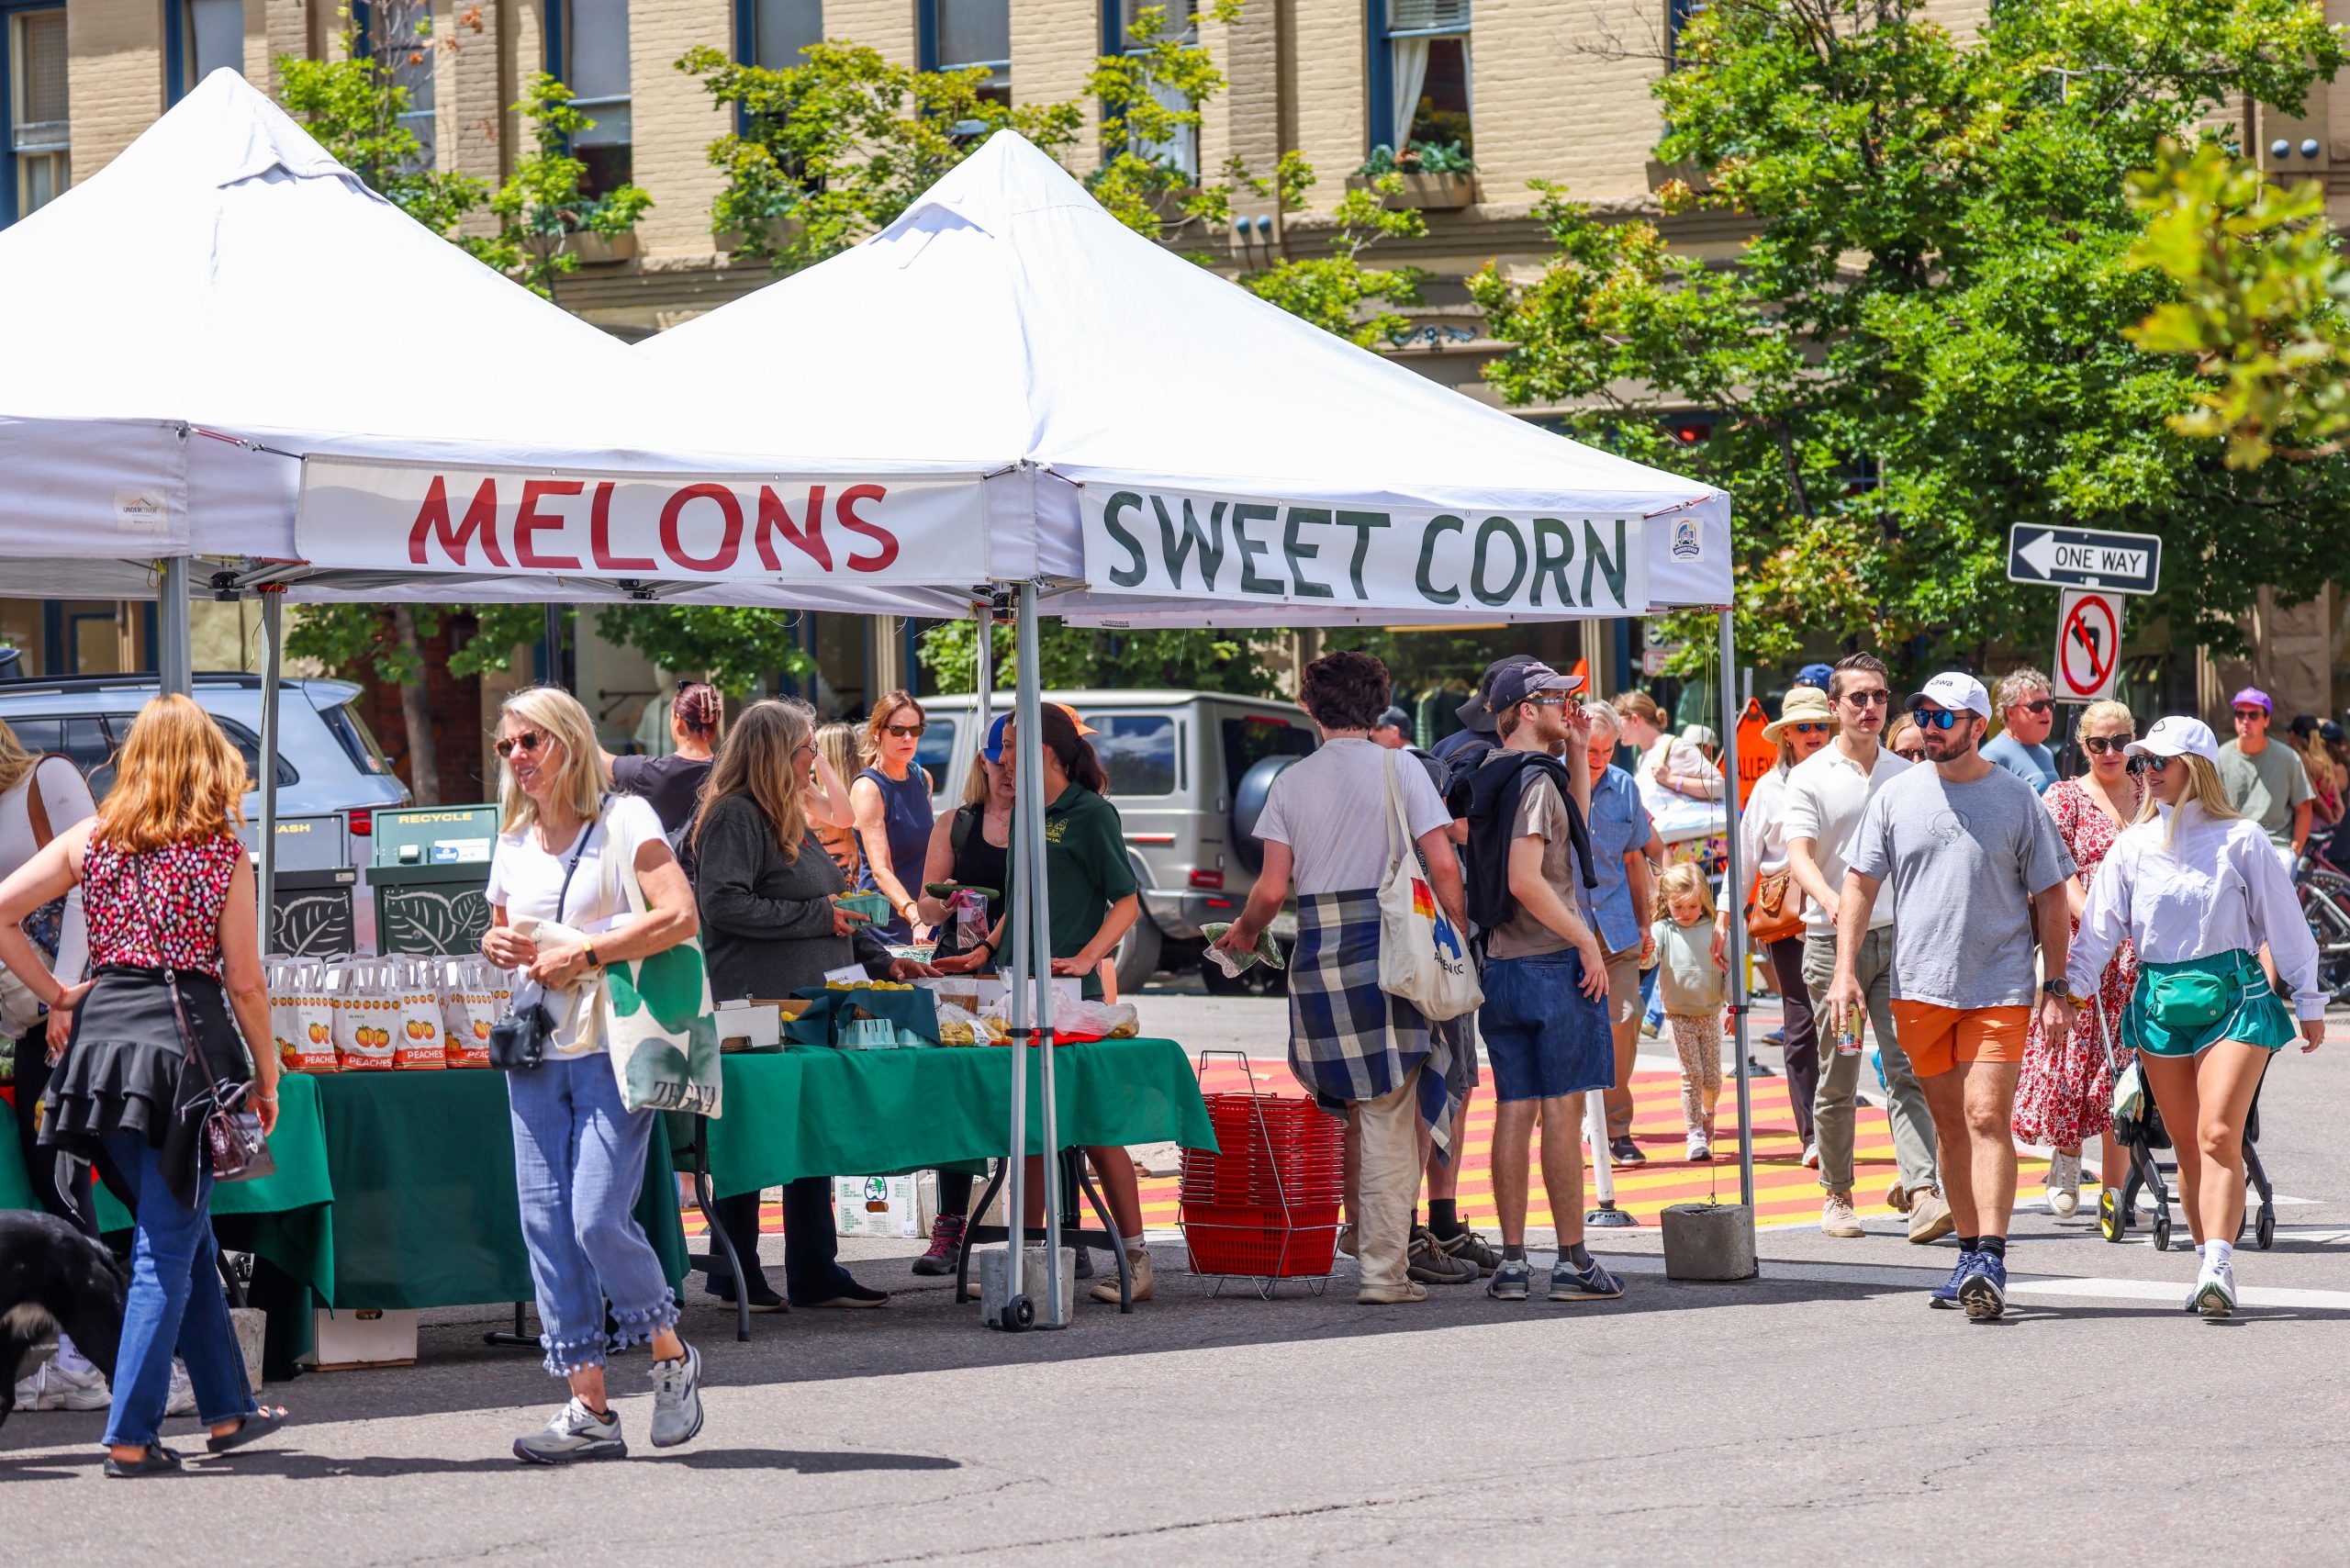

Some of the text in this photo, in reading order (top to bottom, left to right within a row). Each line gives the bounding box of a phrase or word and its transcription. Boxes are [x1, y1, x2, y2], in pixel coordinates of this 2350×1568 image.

[408, 476, 900, 572] MELONS
[1103, 491, 1628, 609] SWEET CORN
[2055, 546, 2142, 573] ONE WAY
[398, 812, 472, 823] RECYCLE
[407, 1050, 443, 1058] PEACHES
[467, 1050, 489, 1058] PEAC
[349, 1057, 392, 1067] PEACHES
